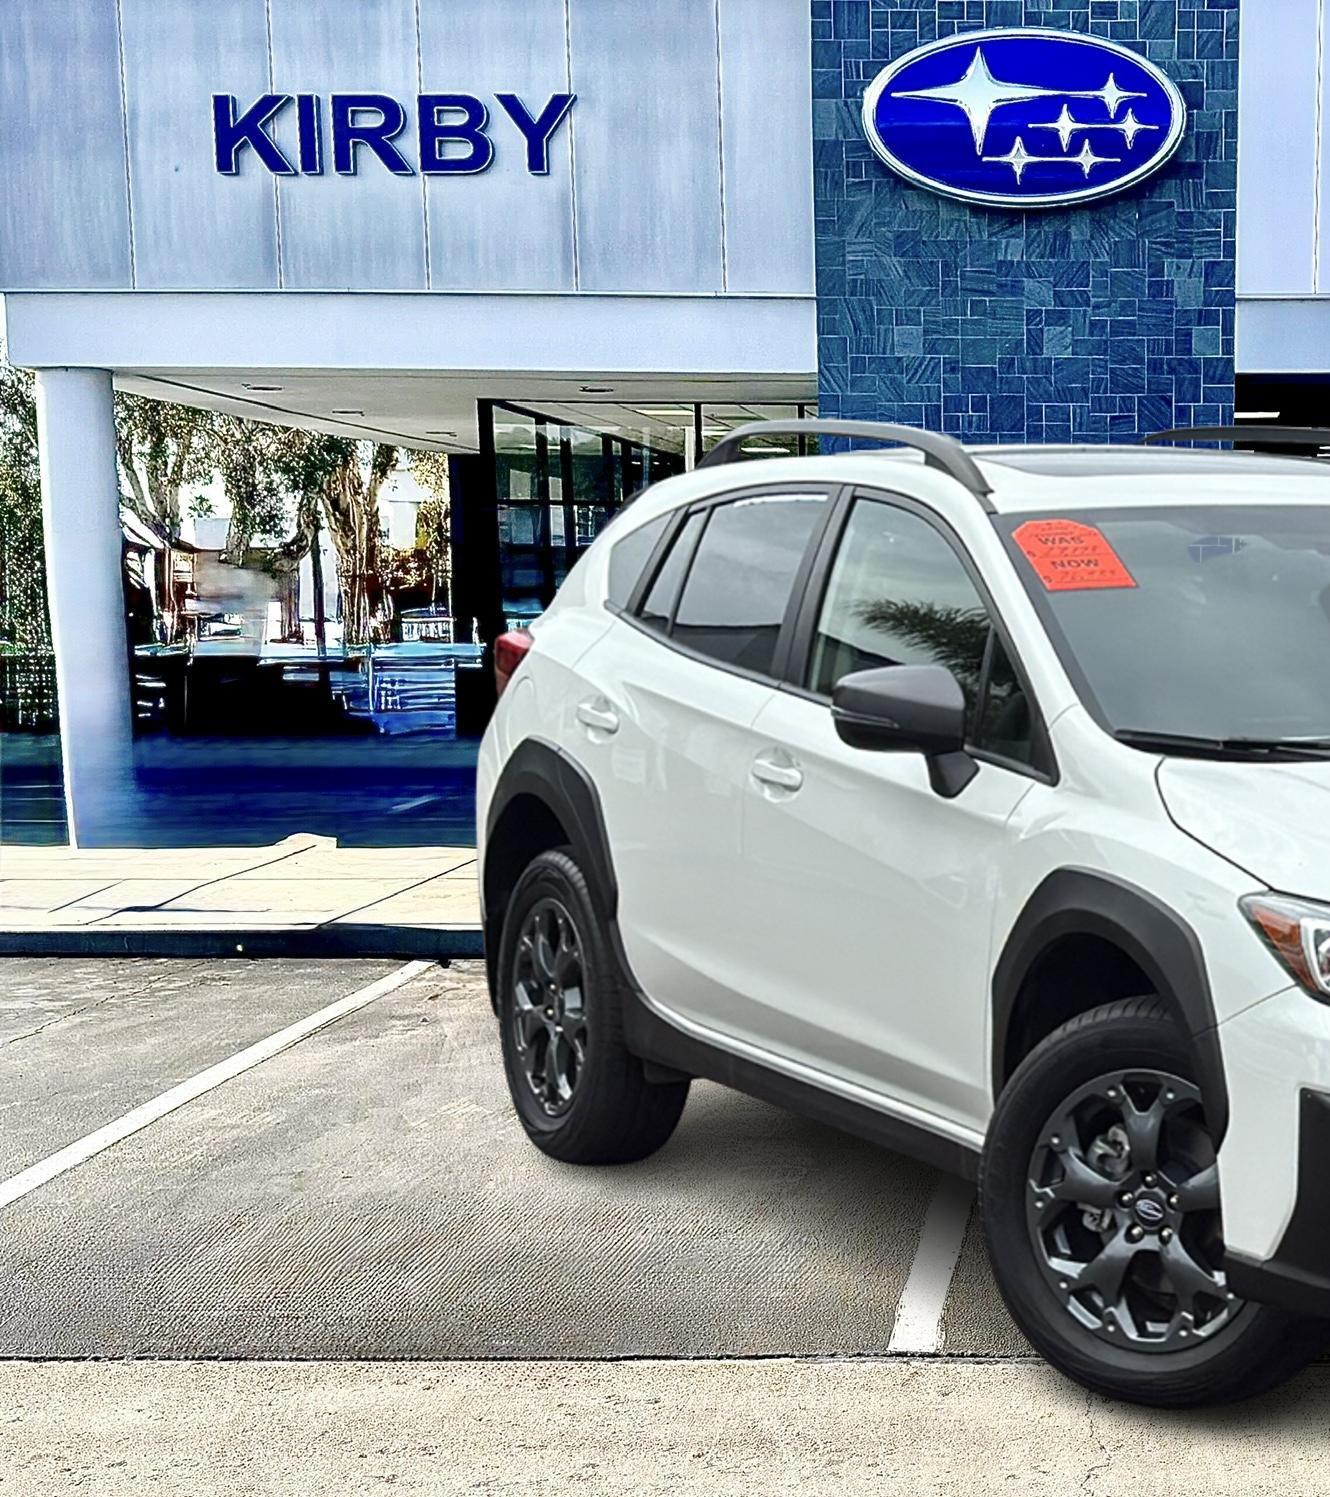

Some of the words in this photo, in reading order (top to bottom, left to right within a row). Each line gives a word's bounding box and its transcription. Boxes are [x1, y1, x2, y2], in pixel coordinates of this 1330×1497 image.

[212, 93, 577, 176] KIRBY
[1037, 535, 1085, 546] WAS
[1050, 558, 1099, 570] NOW
